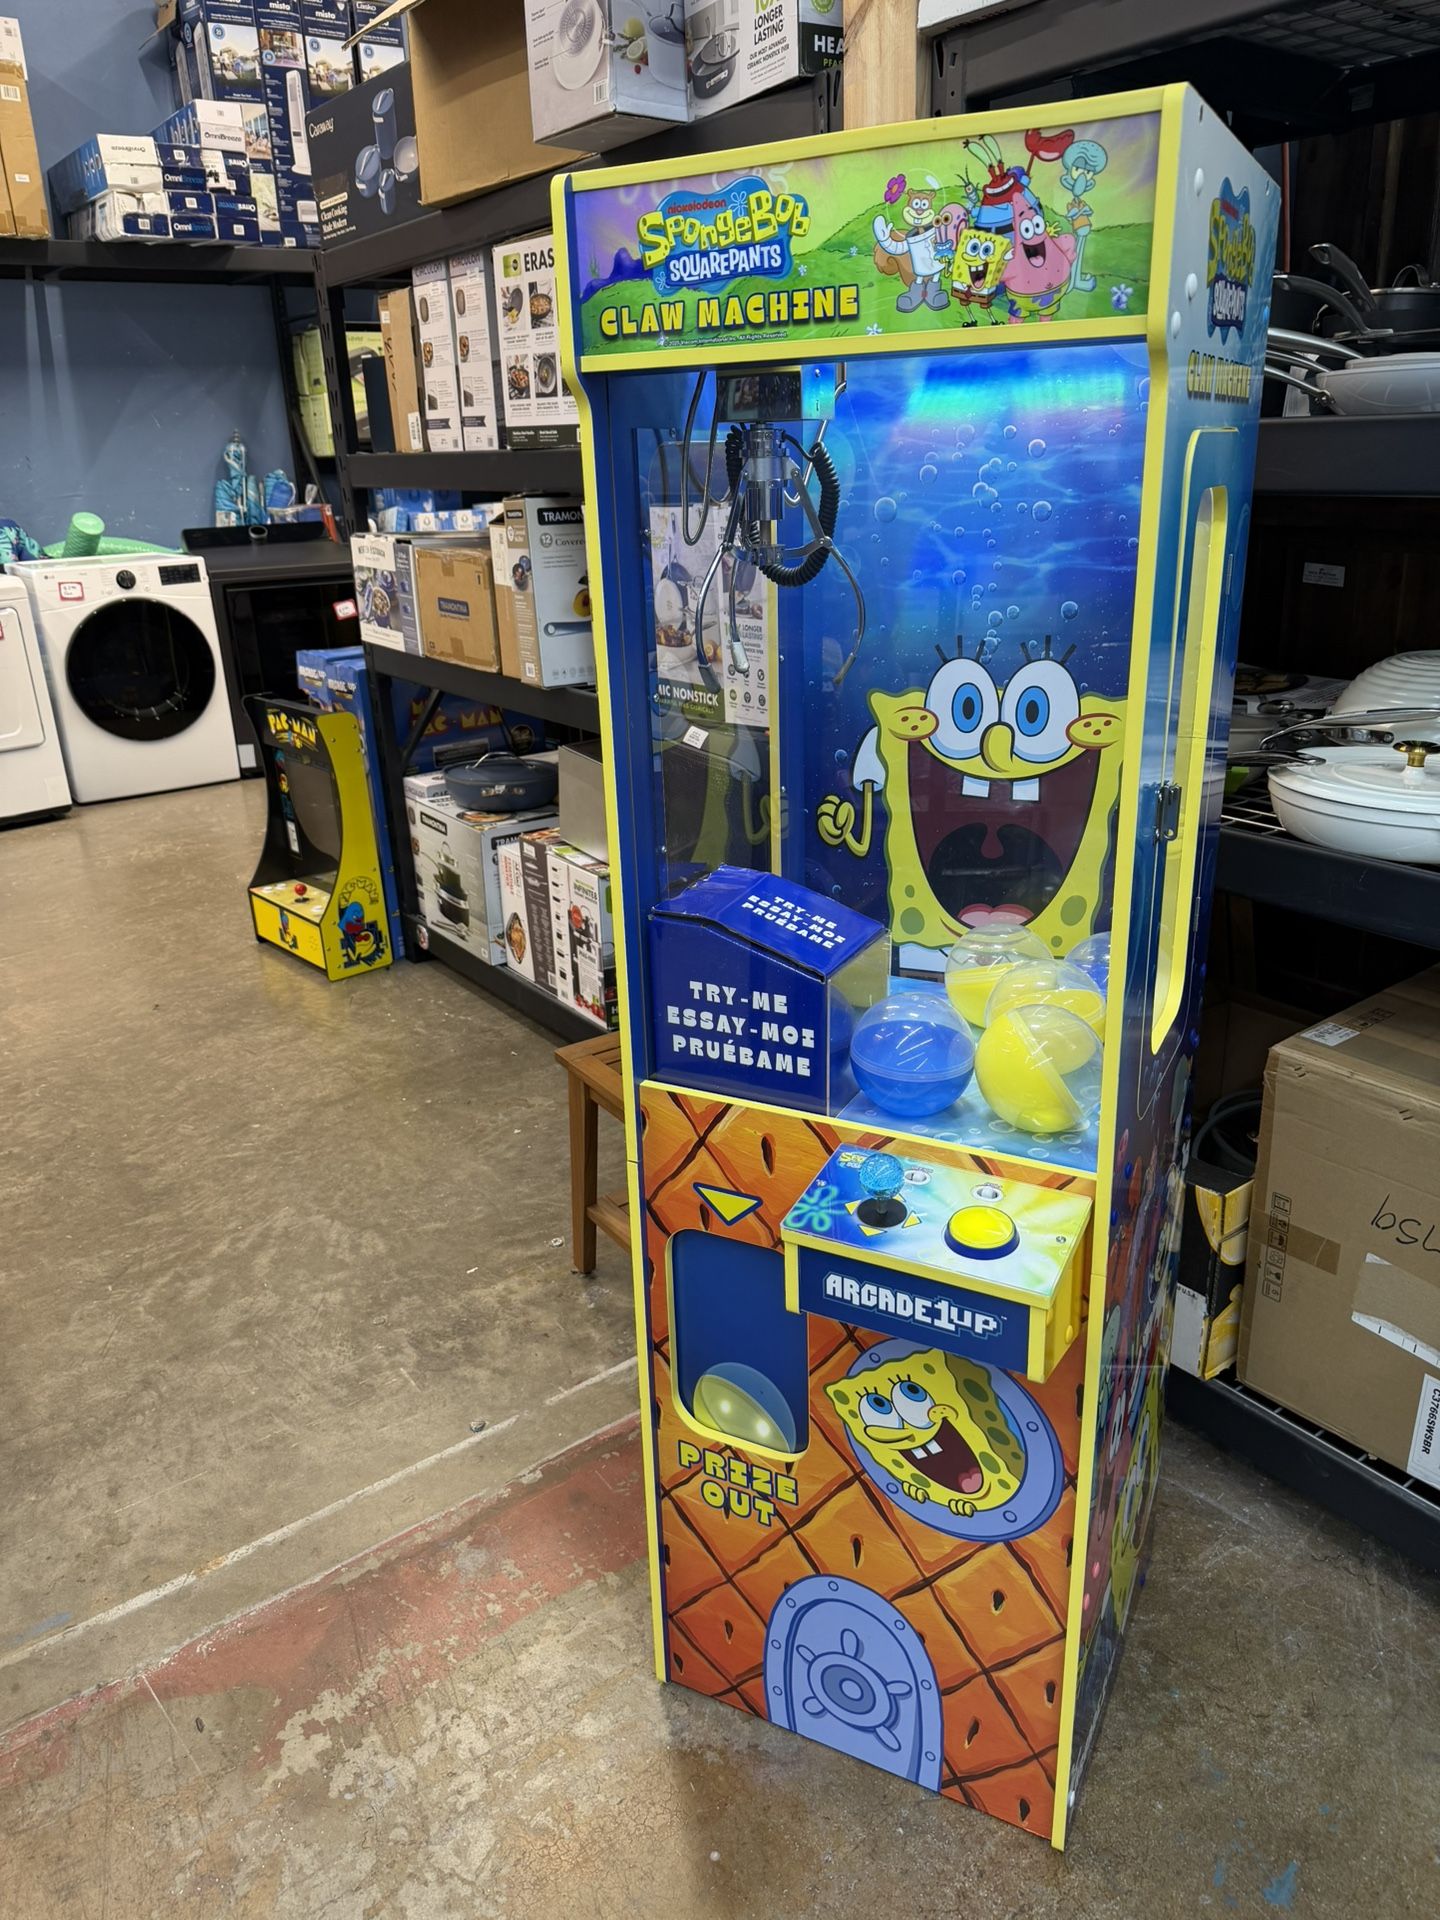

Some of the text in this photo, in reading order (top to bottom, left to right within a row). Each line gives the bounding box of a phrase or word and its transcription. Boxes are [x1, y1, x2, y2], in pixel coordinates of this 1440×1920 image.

[315, 10, 336, 20] misto
[754, 4, 783, 30] LONGER
[754, 20, 784, 46] LASTING
[204, 131, 242, 144] OmniBreeze
[308, 116, 334, 138] Caraway
[666, 199, 728, 214] nickelodeon
[638, 190, 812, 270] SpongeBob
[669, 244, 782, 282] SQUAREPANTS
[600, 284, 859, 337] CLAW MACHINE
[672, 686, 719, 707] NONSTICK
[742, 902, 836, 950] PRUÉBAME
[748, 894, 846, 944] ESSAY-MOI
[774, 896, 837, 930] TRY-ME
[689, 980, 788, 1014] TRY-ME
[666, 1006, 816, 1048] ESSAY-MOI
[672, 1029, 812, 1078] PRUÉBAME
[825, 1273, 998, 1334] ARCADE1UP
[678, 1440, 799, 1506] PRIZE
[701, 1480, 777, 1526] OUT
